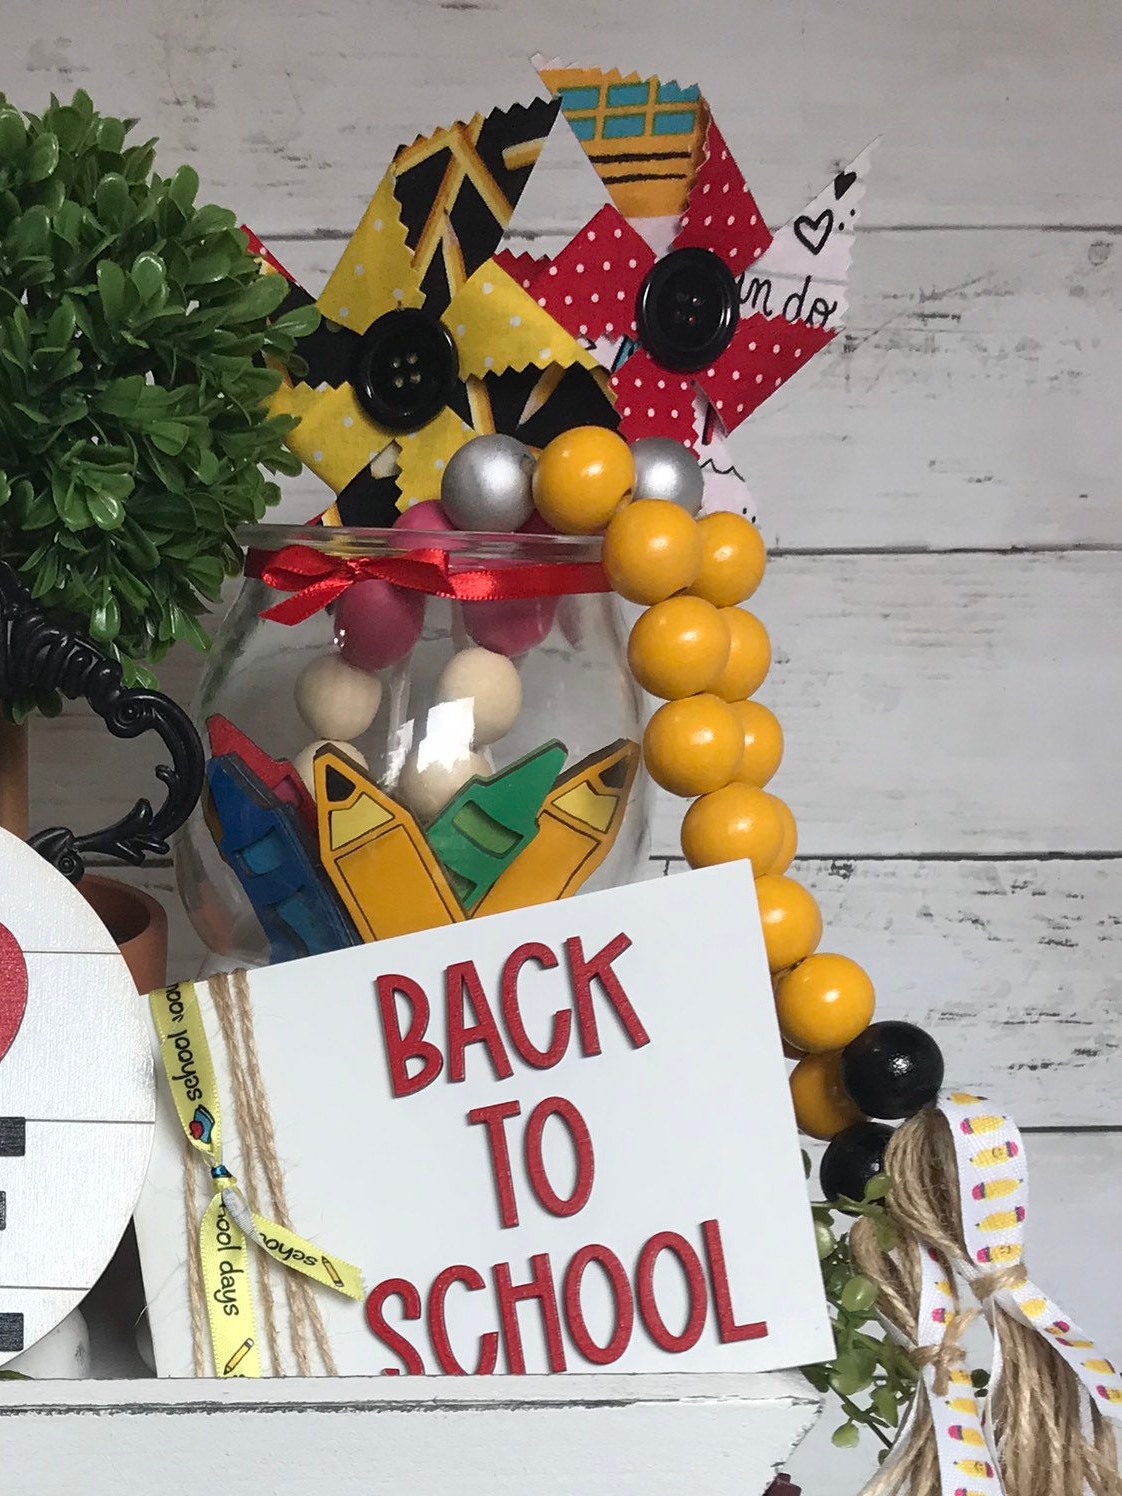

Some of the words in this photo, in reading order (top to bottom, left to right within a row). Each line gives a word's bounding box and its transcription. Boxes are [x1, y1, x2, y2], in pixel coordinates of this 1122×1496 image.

[166, 1028, 203, 1102] school
[373, 931, 651, 1098] BACK
[468, 1095, 596, 1229] TO
[213, 1260, 245, 1317] days
[365, 1218, 769, 1376] SCHOOL
